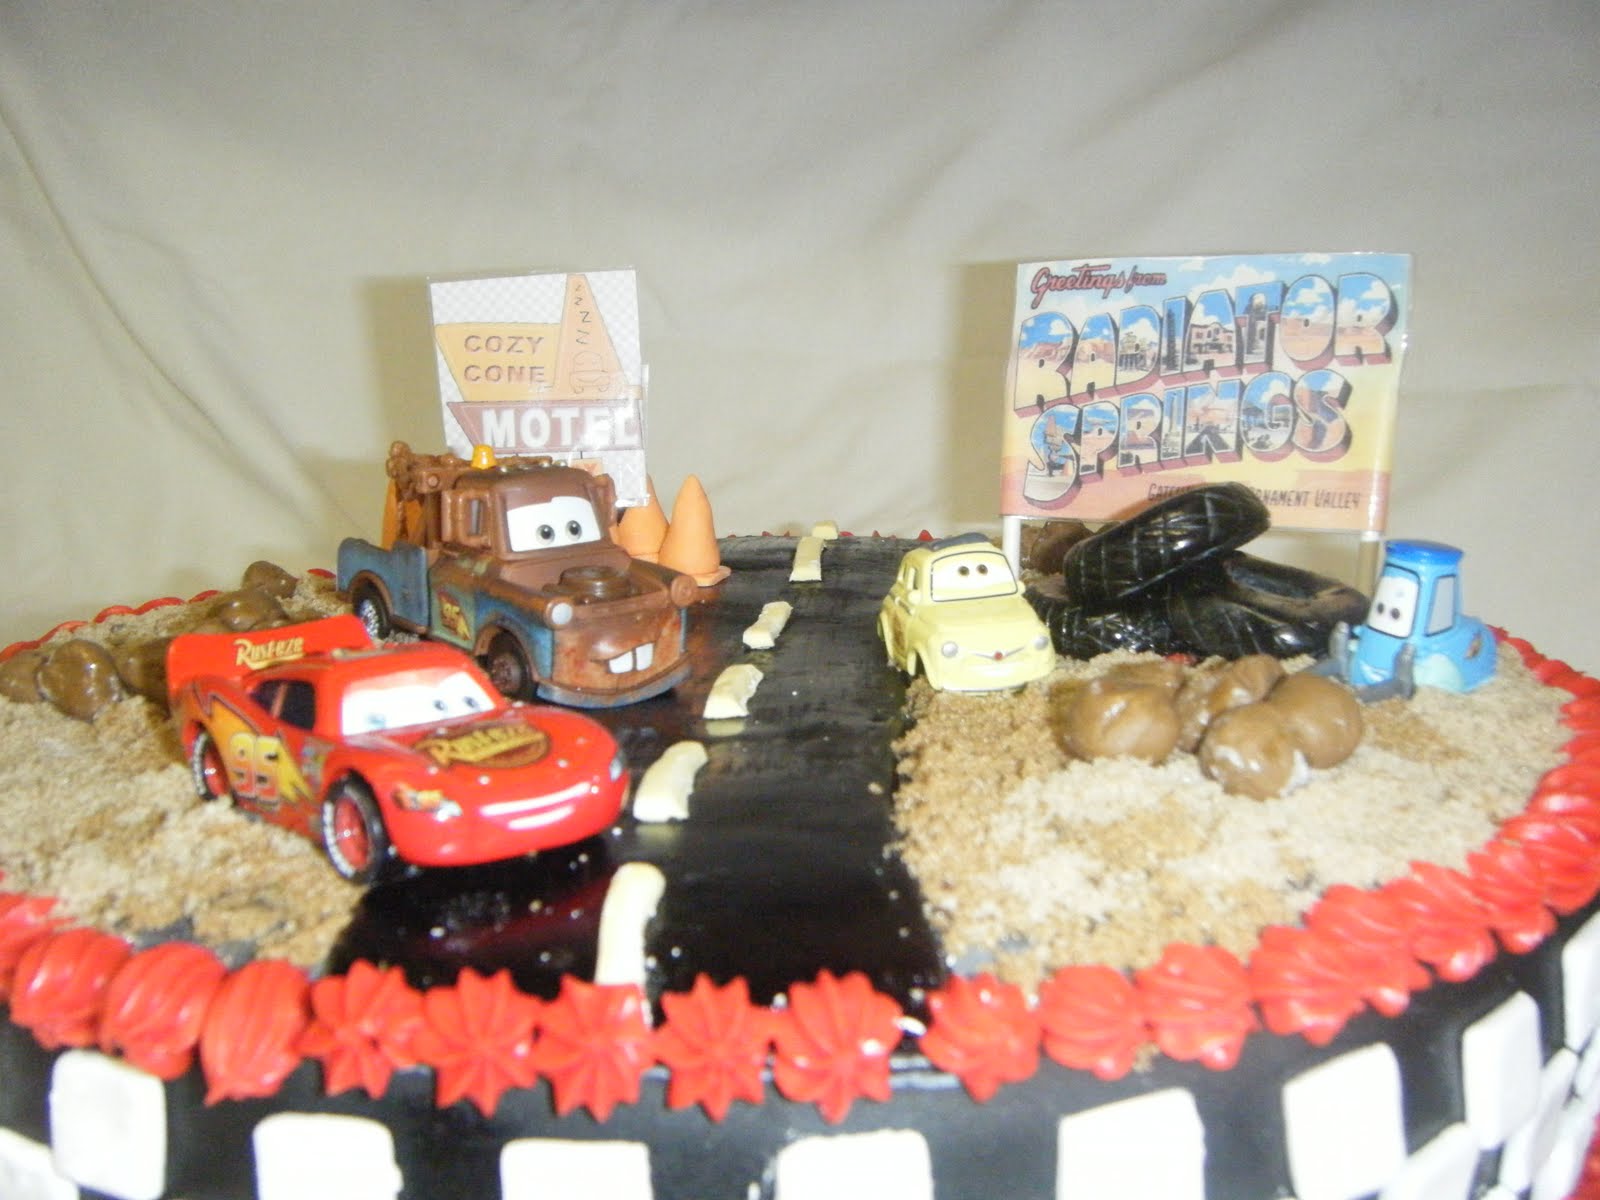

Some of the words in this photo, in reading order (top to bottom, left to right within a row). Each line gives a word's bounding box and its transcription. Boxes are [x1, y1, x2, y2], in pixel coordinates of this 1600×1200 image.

[1031, 264, 1124, 310] Greetings
[464, 335, 544, 353] COZY
[1014, 271, 1399, 417] RADIATOR
[464, 365, 545, 384] CONE
[481, 407, 640, 449] MOTEL
[1023, 369, 1353, 510] SPRINGS
[1314, 489, 1361, 509] VALLEY
